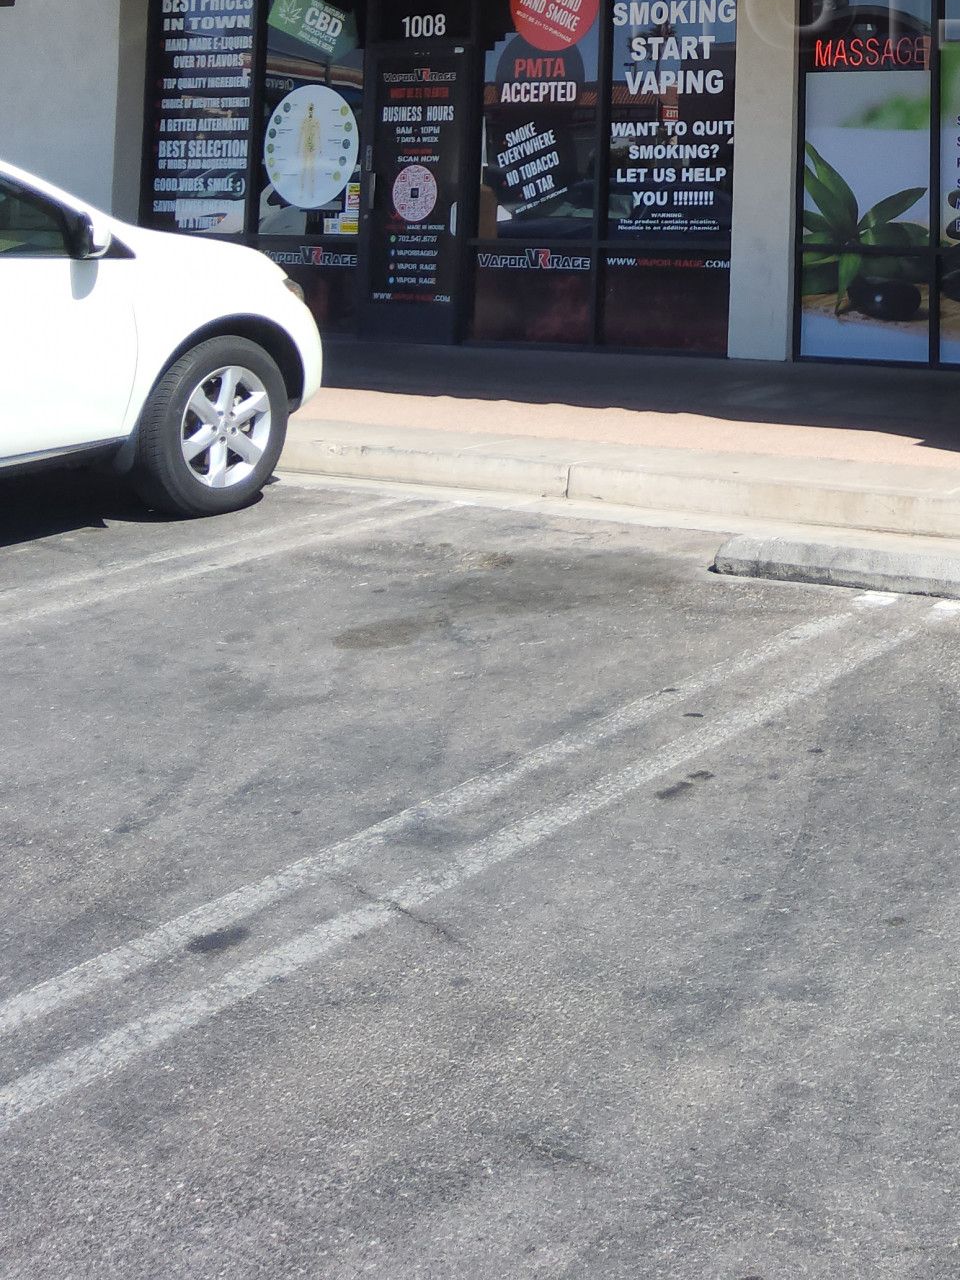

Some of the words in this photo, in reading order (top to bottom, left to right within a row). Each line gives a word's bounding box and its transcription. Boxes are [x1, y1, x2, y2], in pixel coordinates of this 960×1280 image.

[304, 6, 343, 38] CBD
[545, 3, 580, 32] SMOKE
[612, 0, 736, 26] SMOKING
[163, 18, 184, 31] IN
[189, 15, 250, 30] TOWN
[401, 13, 446, 38] 1008
[301, 23, 336, 45] PRODUCTS
[165, 38, 187, 51] HAND
[630, 35, 716, 61] START
[814, 36, 930, 68] MASSAGE
[173, 55, 195, 69] OVER
[207, 53, 244, 68] FLAVORS
[514, 57, 565, 79] PMTA
[163, 78, 176, 89] TOP
[178, 77, 207, 90] QUALITY
[624, 70, 724, 95] VAPING
[501, 81, 577, 103] ACCEPTED
[382, 106, 422, 121] BUSINESS
[427, 105, 454, 121] HOURS
[160, 119, 166, 131] A
[166, 118, 197, 131] BETTER
[420, 125, 440, 134] 10PM
[611, 121, 659, 136] WANT
[664, 121, 688, 136] TO
[692, 120, 734, 136] QUIT
[505, 121, 537, 147] SMOKE
[158, 140, 187, 158] BEST
[187, 139, 248, 157] SELECTION
[497, 129, 557, 168] EVERYWHERE
[628, 144, 720, 160] SMOKING?
[421, 155, 440, 163] NOW
[506, 169, 520, 187] NO
[519, 151, 559, 180] TOBACCO
[616, 168, 648, 183] LET
[653, 168, 677, 183] US
[681, 167, 727, 182] HELP
[154, 178, 178, 191] GOOD
[207, 177, 234, 191] SMILE
[522, 183, 536, 200] NO
[535, 174, 555, 194] TAR
[632, 191, 668, 207] YOU
[322, 252, 357, 266] RAGE
[478, 253, 527, 267] VAPOR
[551, 255, 591, 270] RAGE
